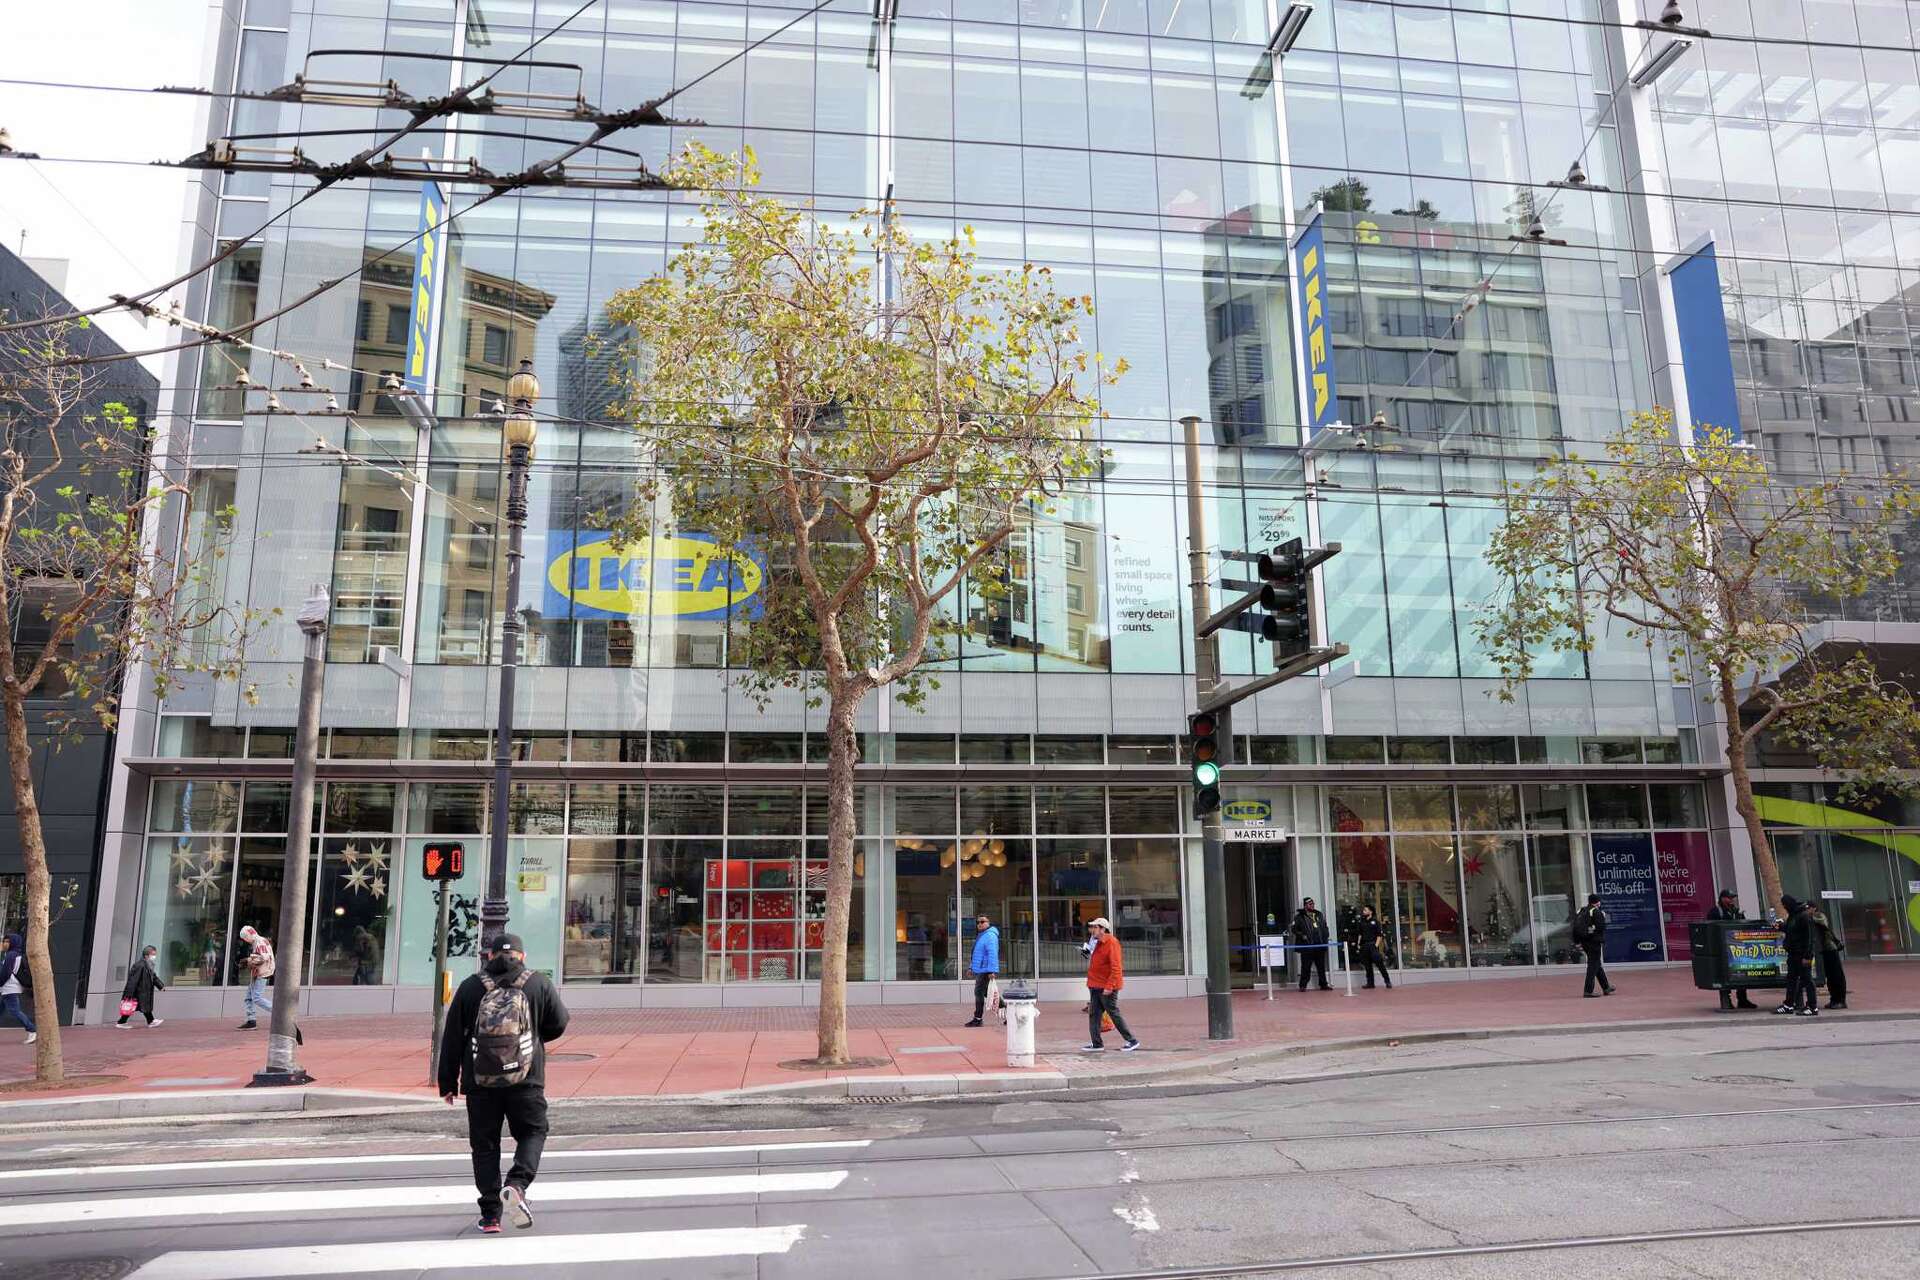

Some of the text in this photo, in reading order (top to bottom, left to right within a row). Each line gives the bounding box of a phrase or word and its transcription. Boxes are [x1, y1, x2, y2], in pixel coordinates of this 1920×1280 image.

[411, 197, 437, 376] IKEA
[1303, 245, 1329, 423] IKEA
[1114, 544, 1122, 552] A
[1114, 556, 1151, 567] refined
[568, 557, 748, 592] IKEA
[1115, 570, 1173, 582] small space
[1115, 583, 1143, 595] living
[1116, 596, 1148, 606] where
[1116, 609, 1175, 621] every detail
[1117, 623, 1155, 632] counts.
[1227, 806, 1266, 815] IKEA
[1234, 830, 1277, 839] MARKET
[1596, 851, 1635, 864] Get an
[1657, 851, 1679, 866] Hej,
[1598, 866, 1652, 880] unlimited
[1659, 867, 1689, 878] we're
[1600, 881, 1645, 895] 15% off!
[1660, 882, 1696, 897] hiring!
[1729, 944, 1759, 959] POTTED
